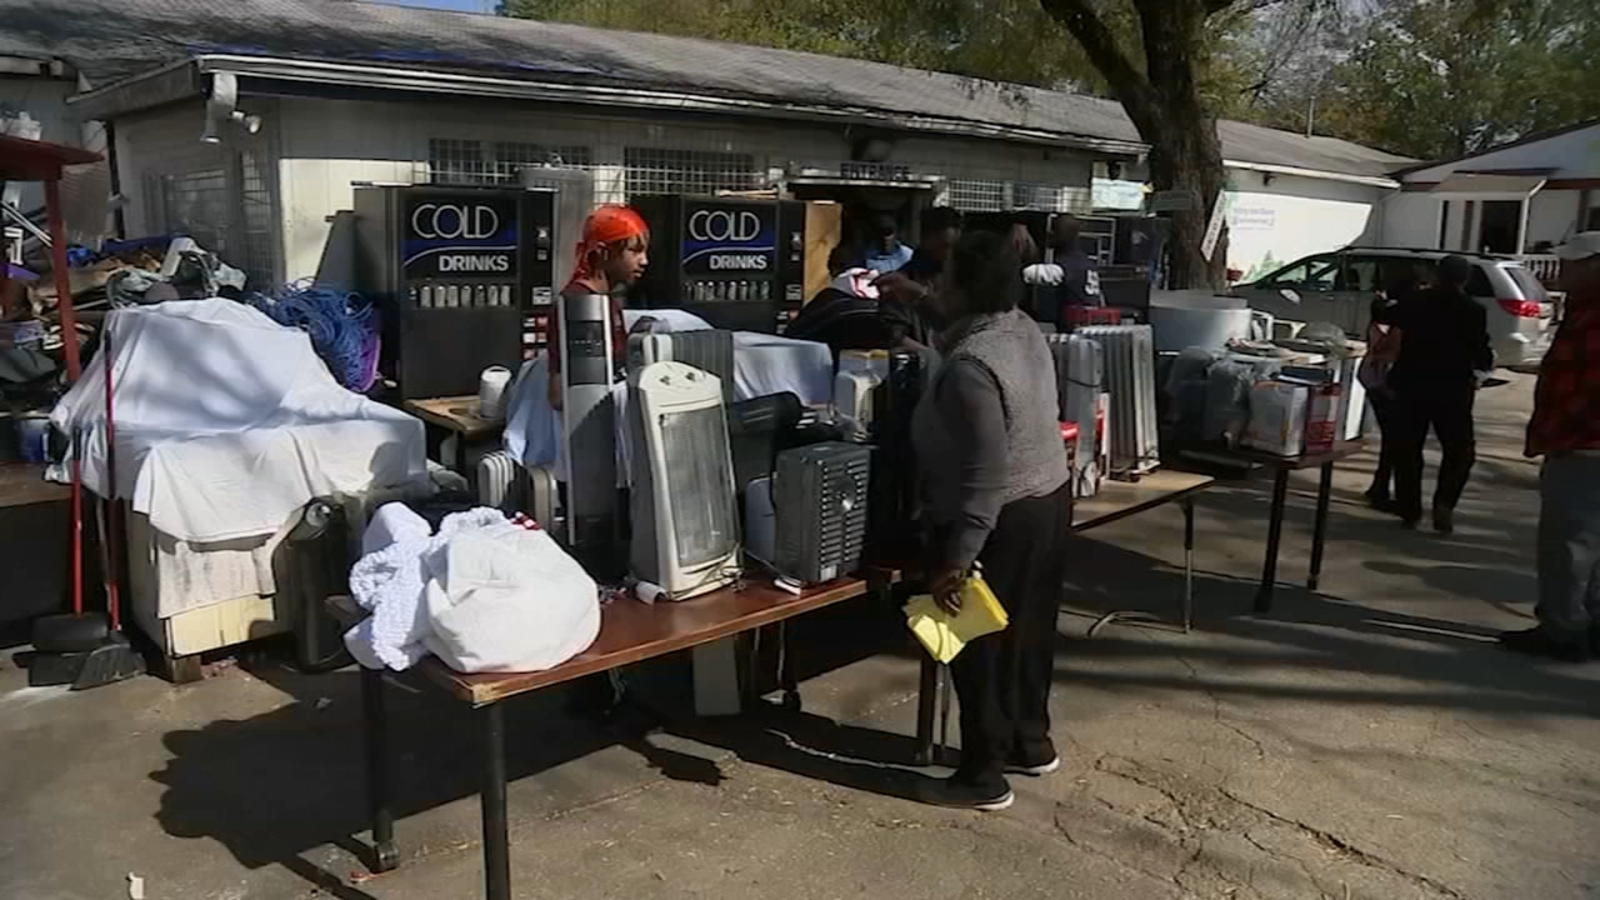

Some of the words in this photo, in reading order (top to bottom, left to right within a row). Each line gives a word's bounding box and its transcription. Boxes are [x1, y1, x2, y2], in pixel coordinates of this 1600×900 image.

[412, 203, 499, 239] COLD
[689, 210, 760, 241] COLD
[438, 255, 509, 272] DRINKS
[709, 254, 768, 270] DRINKS
